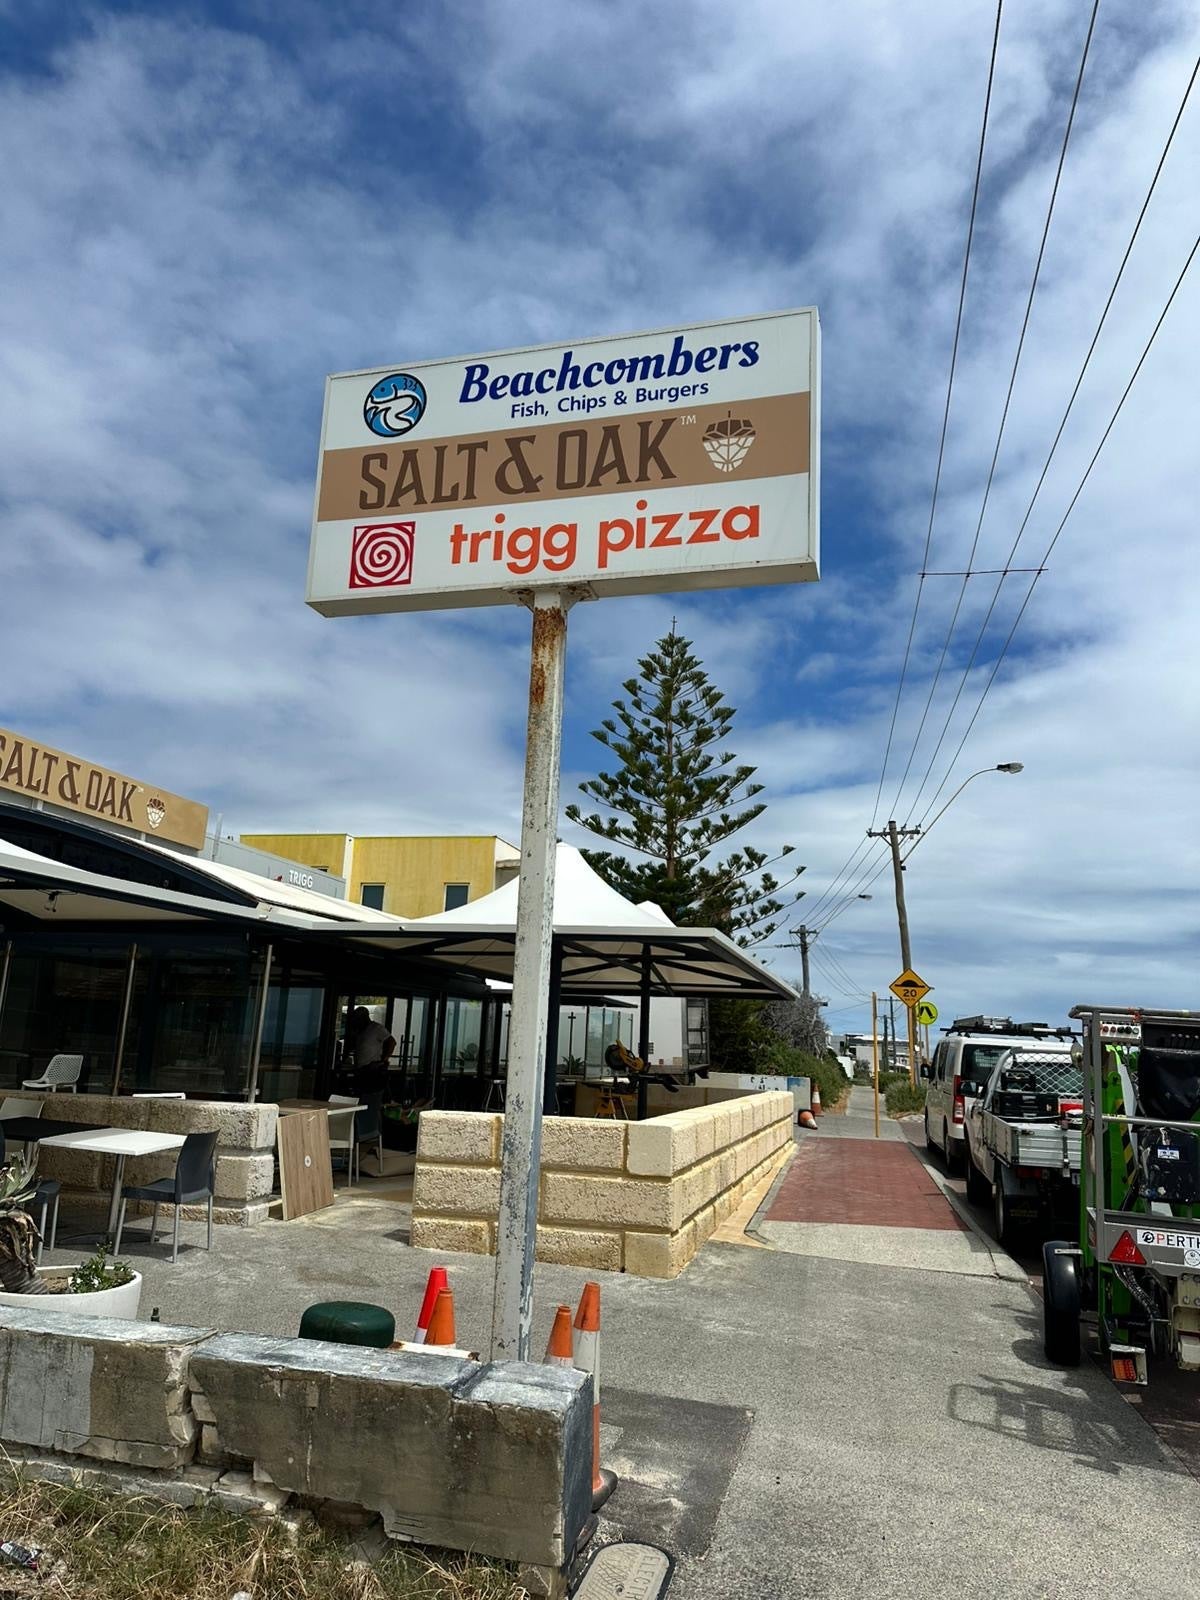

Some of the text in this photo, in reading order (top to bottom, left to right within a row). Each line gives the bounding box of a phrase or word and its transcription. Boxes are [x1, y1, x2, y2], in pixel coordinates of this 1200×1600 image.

[459, 336, 760, 403] Beachcombers
[510, 382, 709, 419] Fish, Chips & Burgers
[359, 440, 488, 511] SALT
[494, 434, 545, 495] &
[556, 417, 678, 491] OAK
[450, 499, 761, 575] trigg pizza
[58, 760, 82, 805] &
[85, 769, 138, 823] OAK
[289, 869, 313, 889] TRIGG
[903, 988, 917, 997] 20
